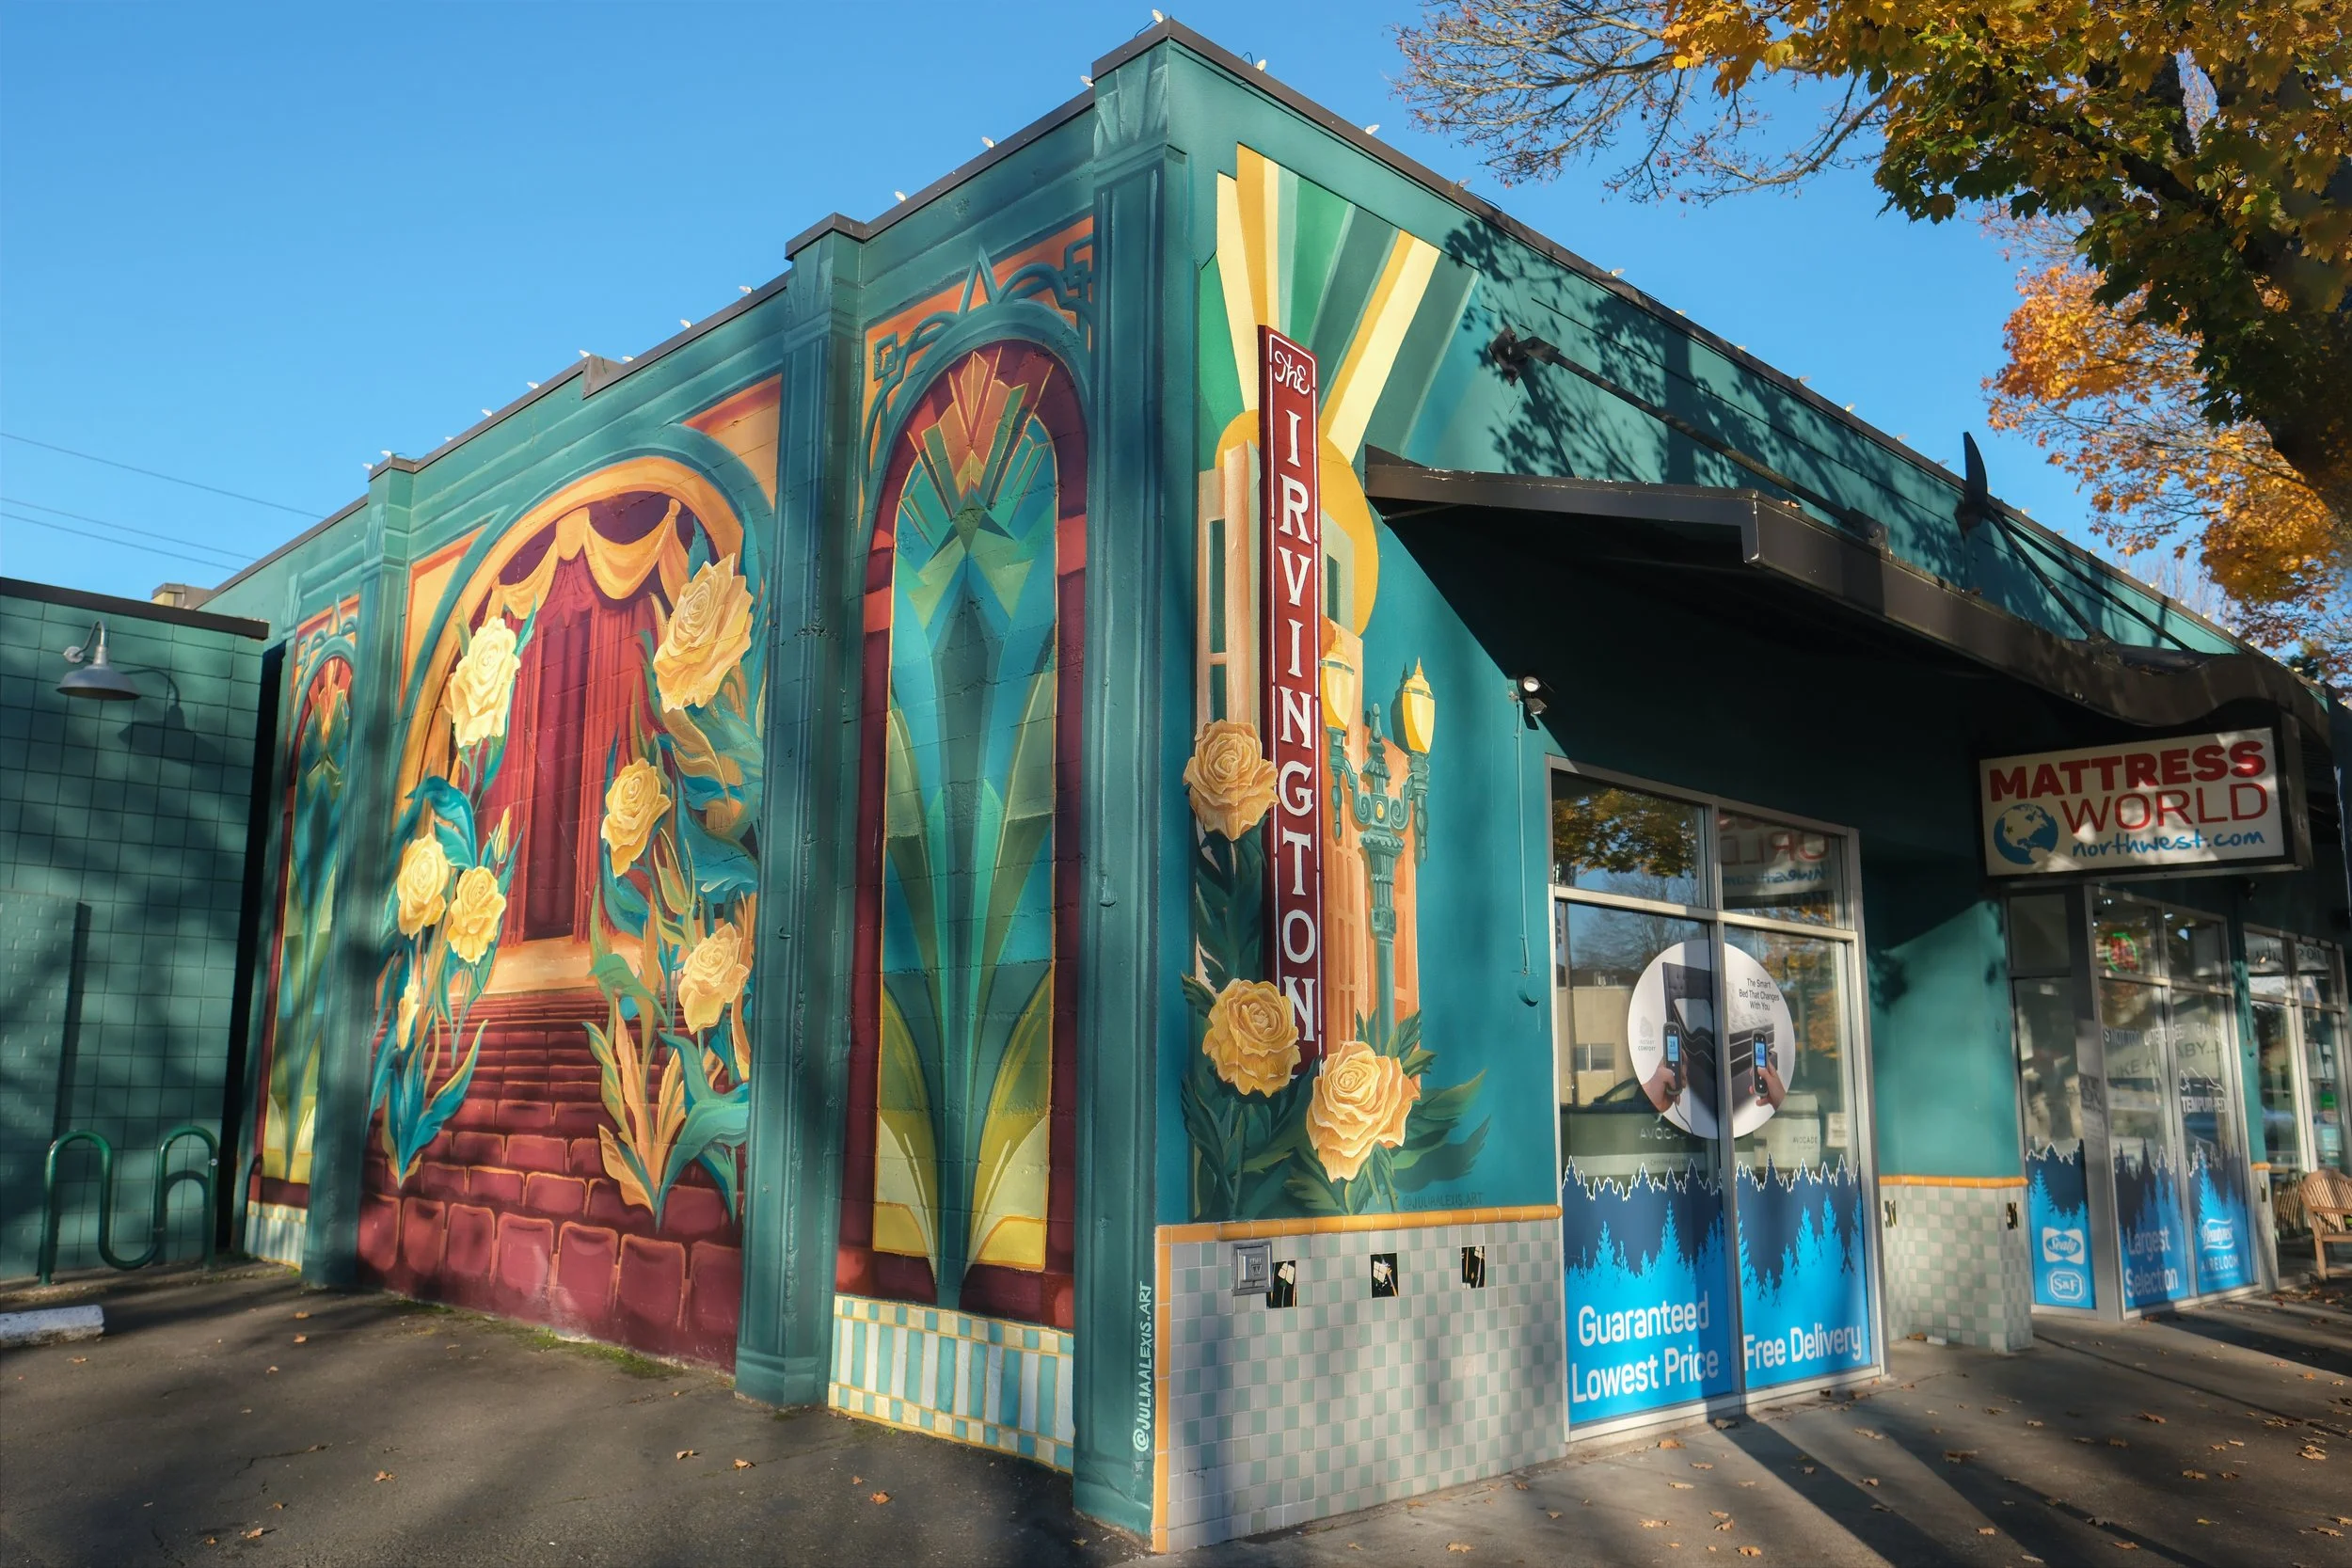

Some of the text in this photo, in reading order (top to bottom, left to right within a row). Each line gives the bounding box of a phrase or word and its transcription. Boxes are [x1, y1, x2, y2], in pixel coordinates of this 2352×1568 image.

[1278, 409, 1316, 1042] IRVINGTON
[1988, 740, 2267, 801] MATTRESS
[2059, 782, 2268, 833] WORLD
[2072, 829, 2265, 857] northwest.com
[1739, 989, 1780, 1003] Bed That Changes
[1747, 977, 1772, 989] The Smart
[1750, 1001, 1771, 1011] With You
[2052, 1237, 2077, 1254] Sealy
[2126, 1226, 2171, 1262] Largest
[2125, 1265, 2179, 1298] Selection
[1578, 1291, 1710, 1347] Guaranteed
[1132, 1280, 1152, 1452] @JULIAALEXIS.ART
[1743, 1323, 1863, 1371] Free Delivery
[1571, 1345, 1719, 1403] Lowest Price
